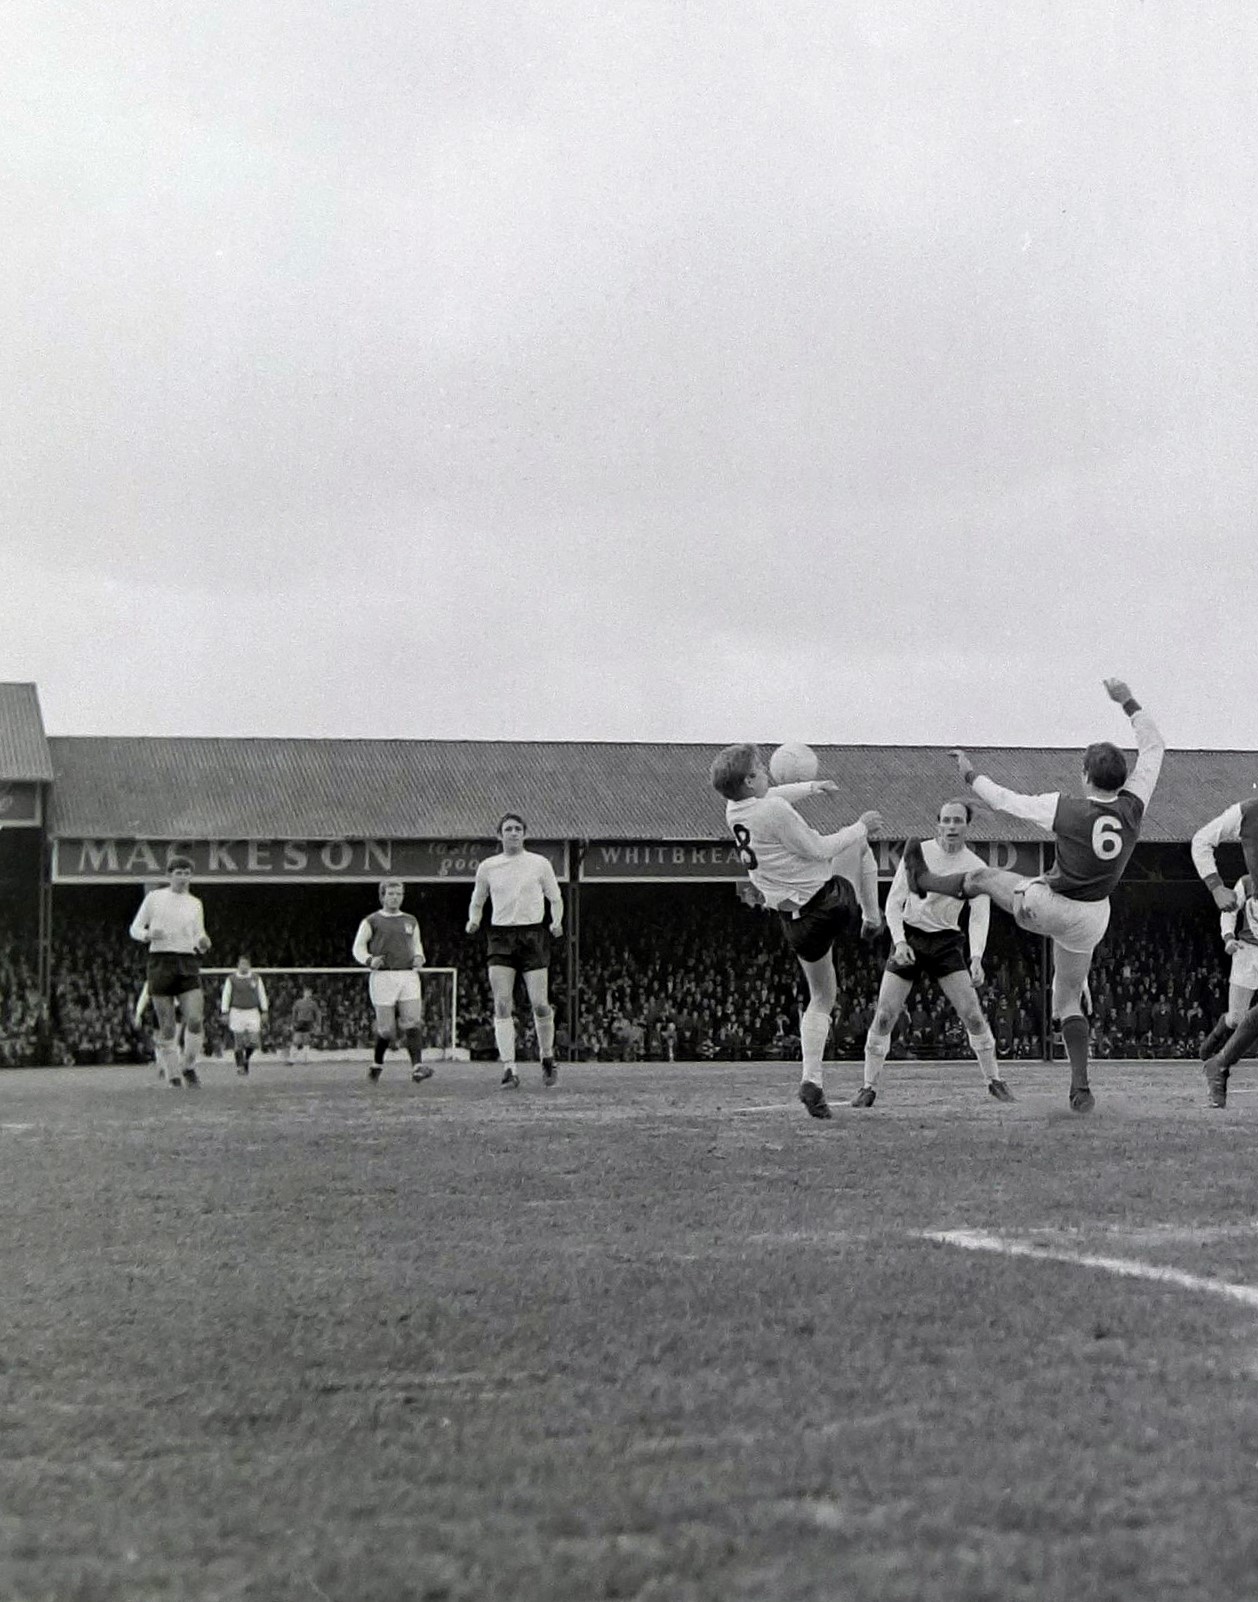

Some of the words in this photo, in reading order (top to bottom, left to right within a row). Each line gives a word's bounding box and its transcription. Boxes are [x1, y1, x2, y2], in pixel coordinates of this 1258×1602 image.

[733, 823, 758, 870] 8
[1092, 815, 1123, 861] 6
[437, 857, 481, 876] goo
[600, 846, 745, 864] WHITBREA
